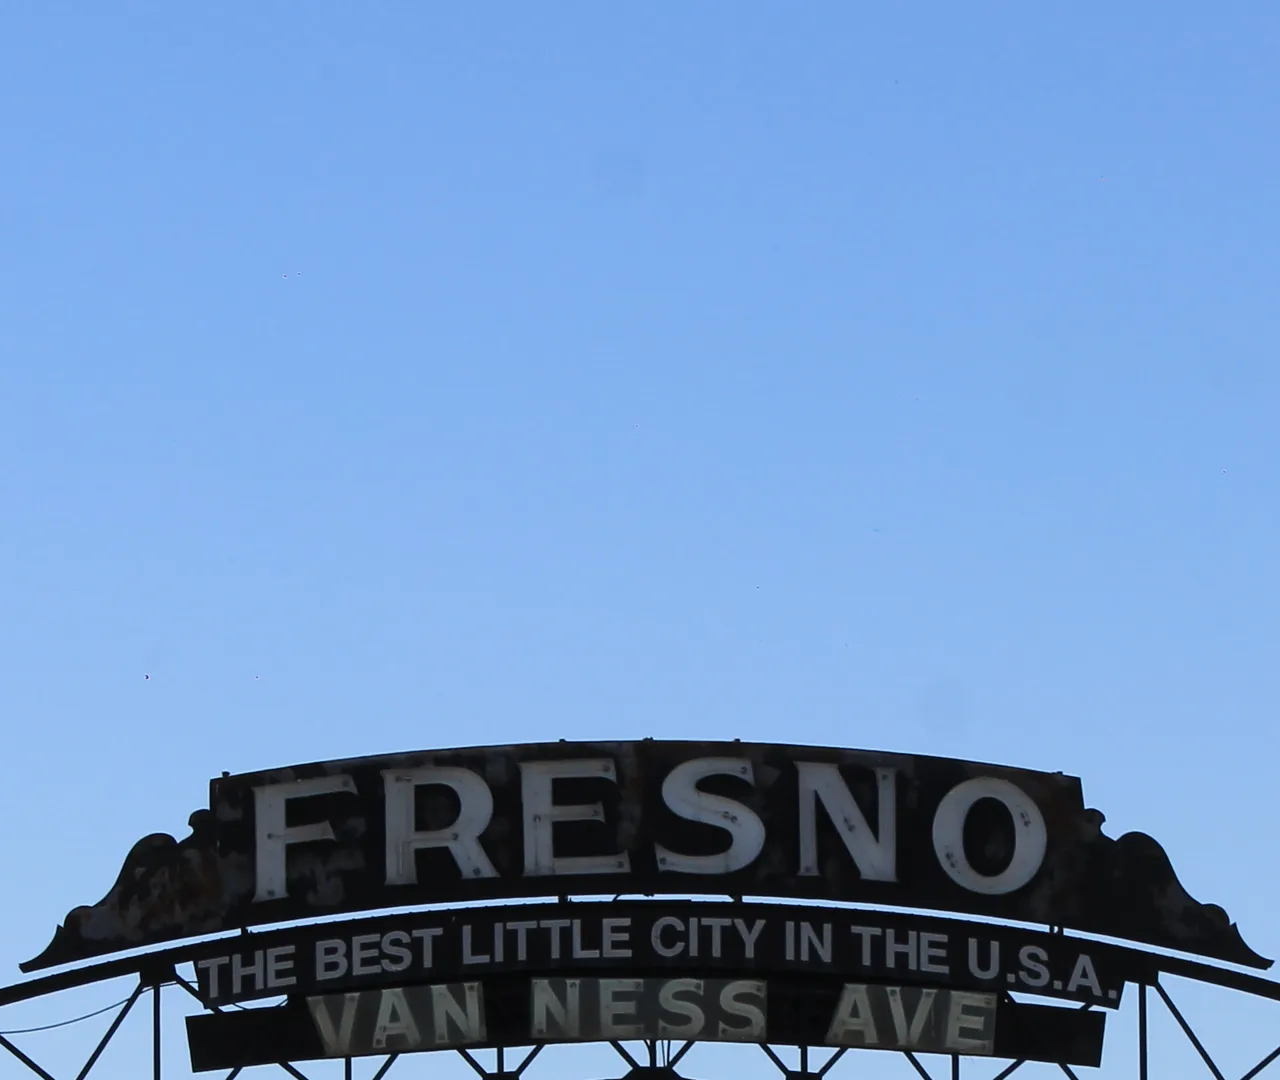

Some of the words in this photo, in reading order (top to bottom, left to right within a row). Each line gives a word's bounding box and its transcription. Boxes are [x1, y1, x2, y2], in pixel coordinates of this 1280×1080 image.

[253, 757, 1048, 903] FRESNO
[198, 945, 297, 998] THE
[315, 927, 443, 981] BEST
[462, 918, 632, 965] LITTLE
[651, 916, 766, 959] CITY
[785, 921, 832, 963] IN
[851, 925, 949, 974] THE
[968, 937, 1118, 999] U.S.A.
[306, 981, 485, 1056] VAN
[531, 977, 767, 1040] NESS
[825, 983, 995, 1054] AVE
